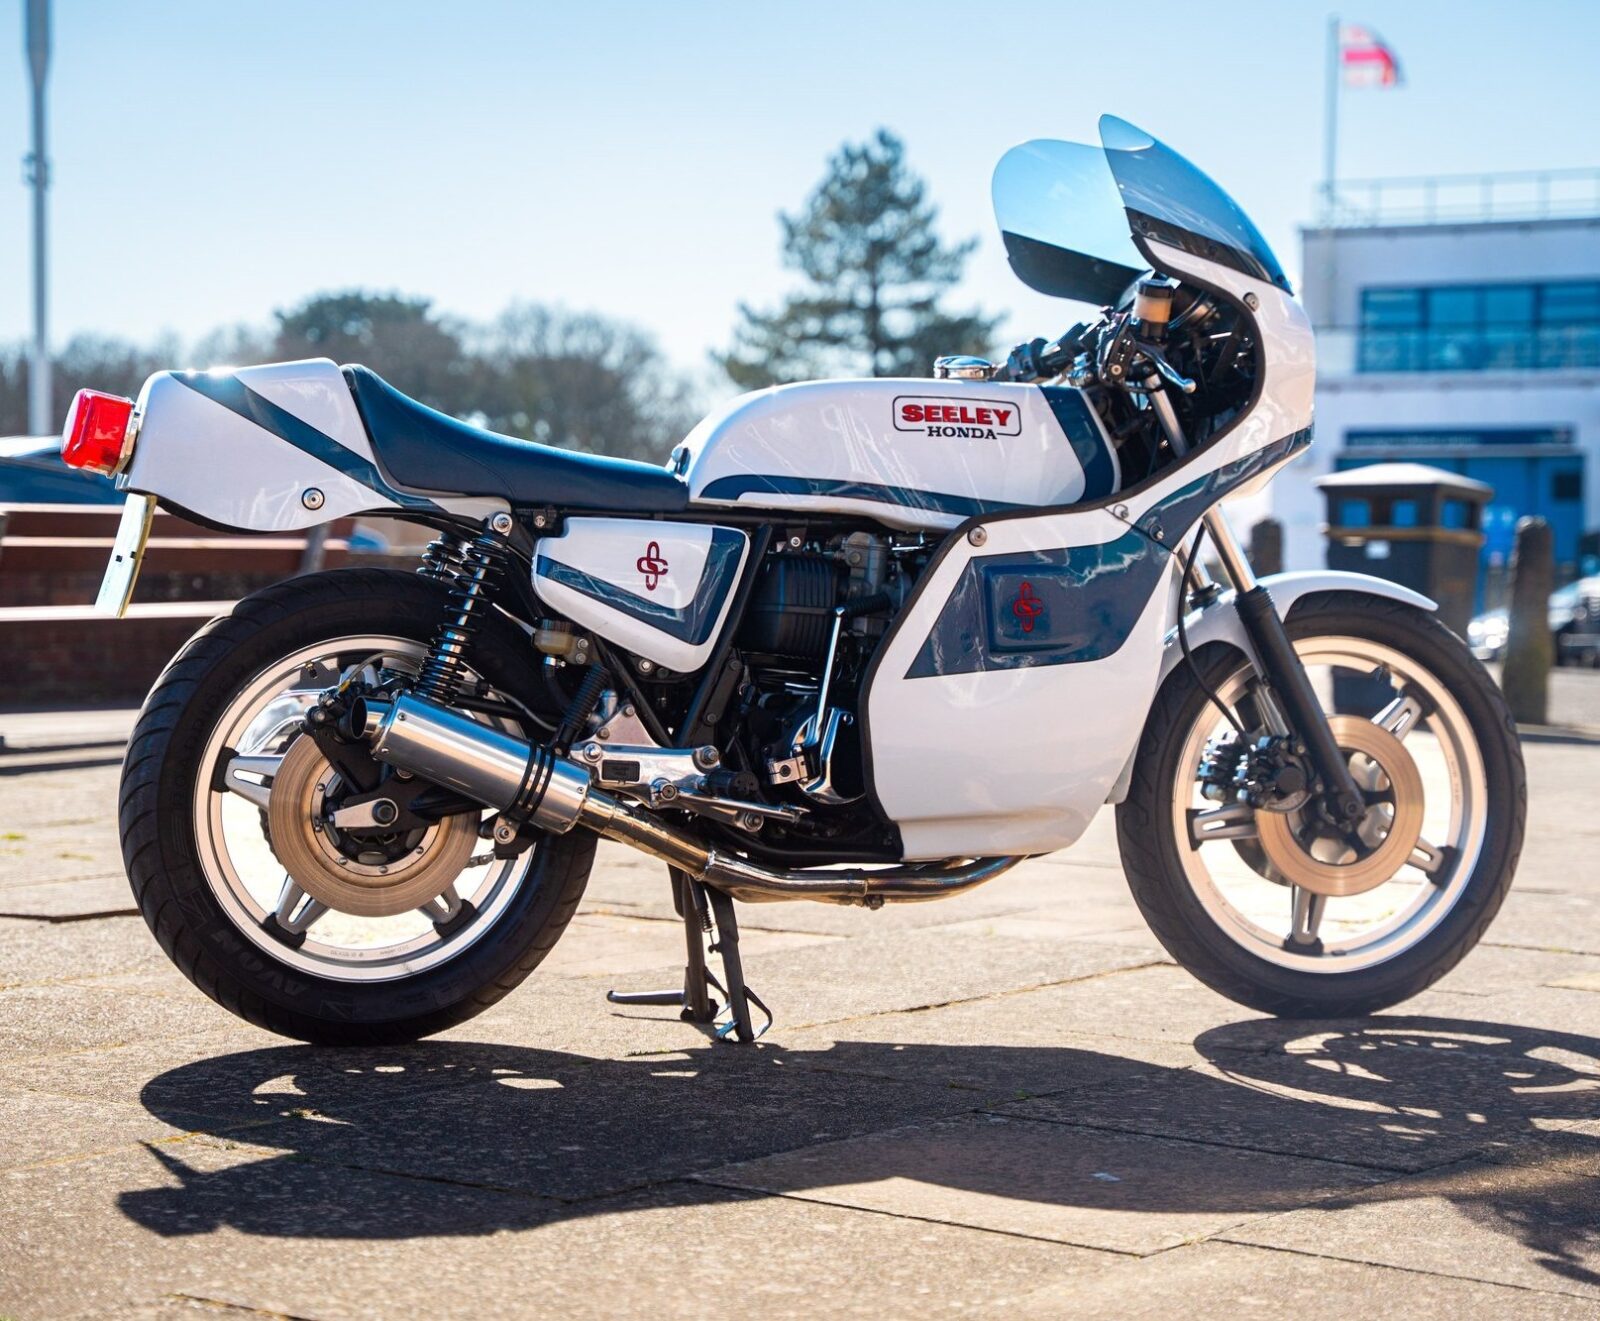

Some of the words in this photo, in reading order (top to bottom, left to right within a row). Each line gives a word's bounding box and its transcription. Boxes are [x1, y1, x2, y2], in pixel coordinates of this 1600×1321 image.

[902, 404, 1012, 426] SEELEY
[927, 426, 998, 440] HONDA
[209, 929, 312, 997] AVON
